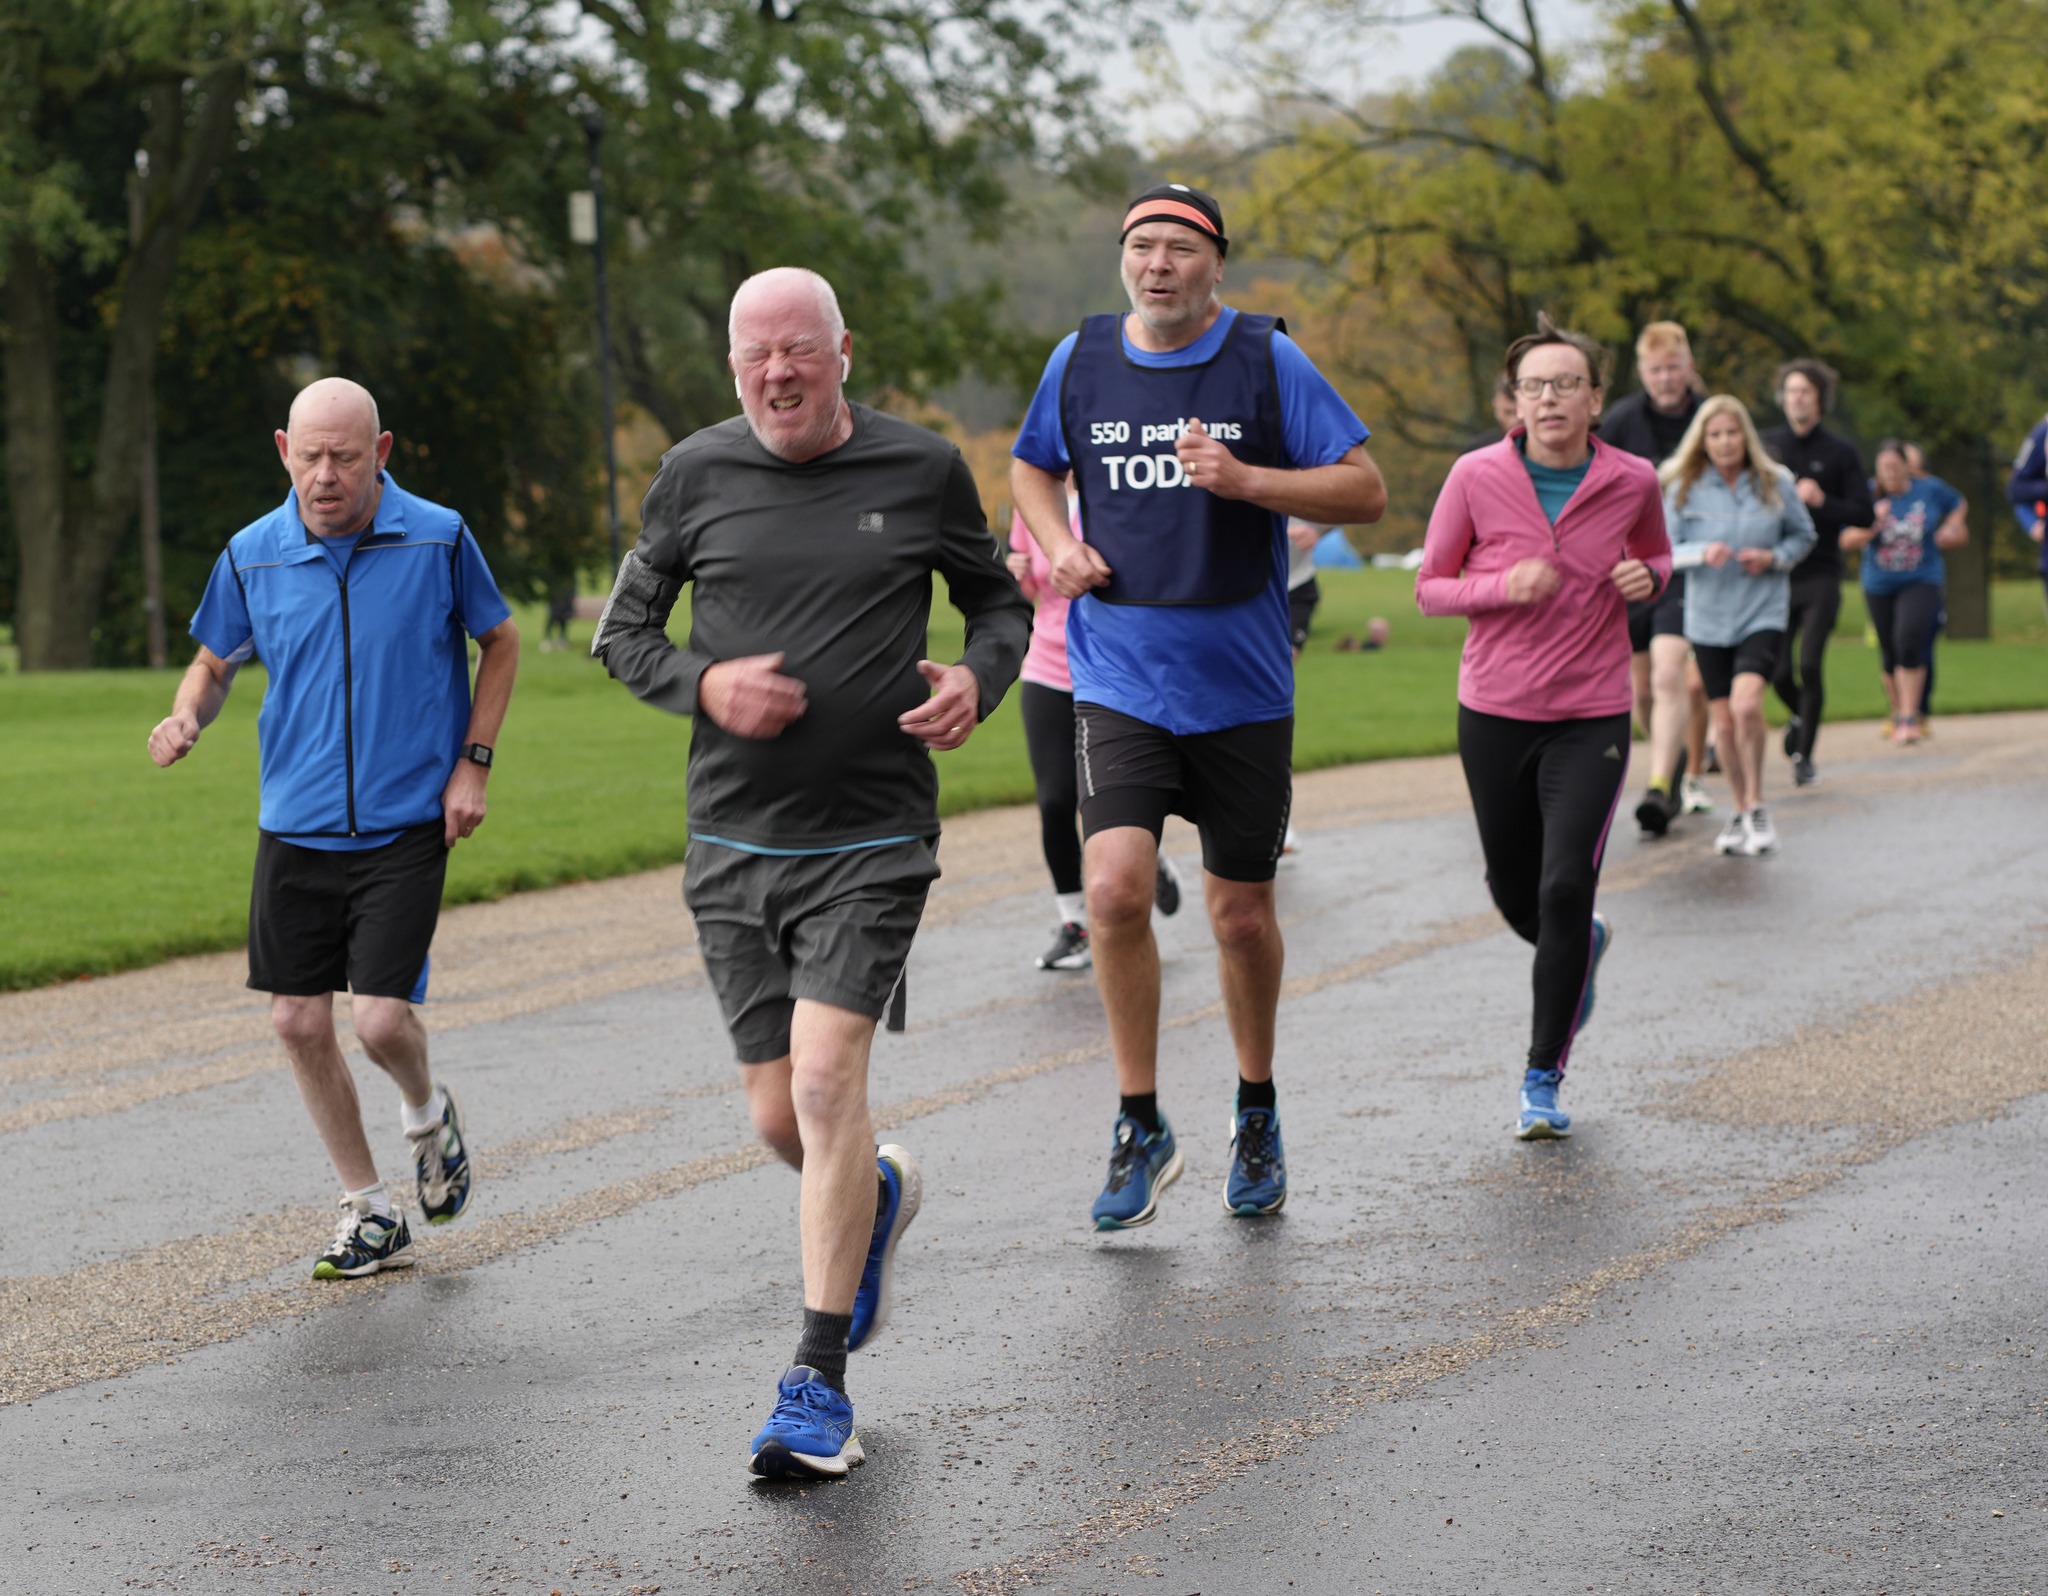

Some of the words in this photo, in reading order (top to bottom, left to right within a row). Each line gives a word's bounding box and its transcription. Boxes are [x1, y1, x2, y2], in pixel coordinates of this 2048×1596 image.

[1090, 421, 1130, 445] 550
[1141, 417, 1242, 447] parkuns
[1101, 454, 1193, 490] TOD
